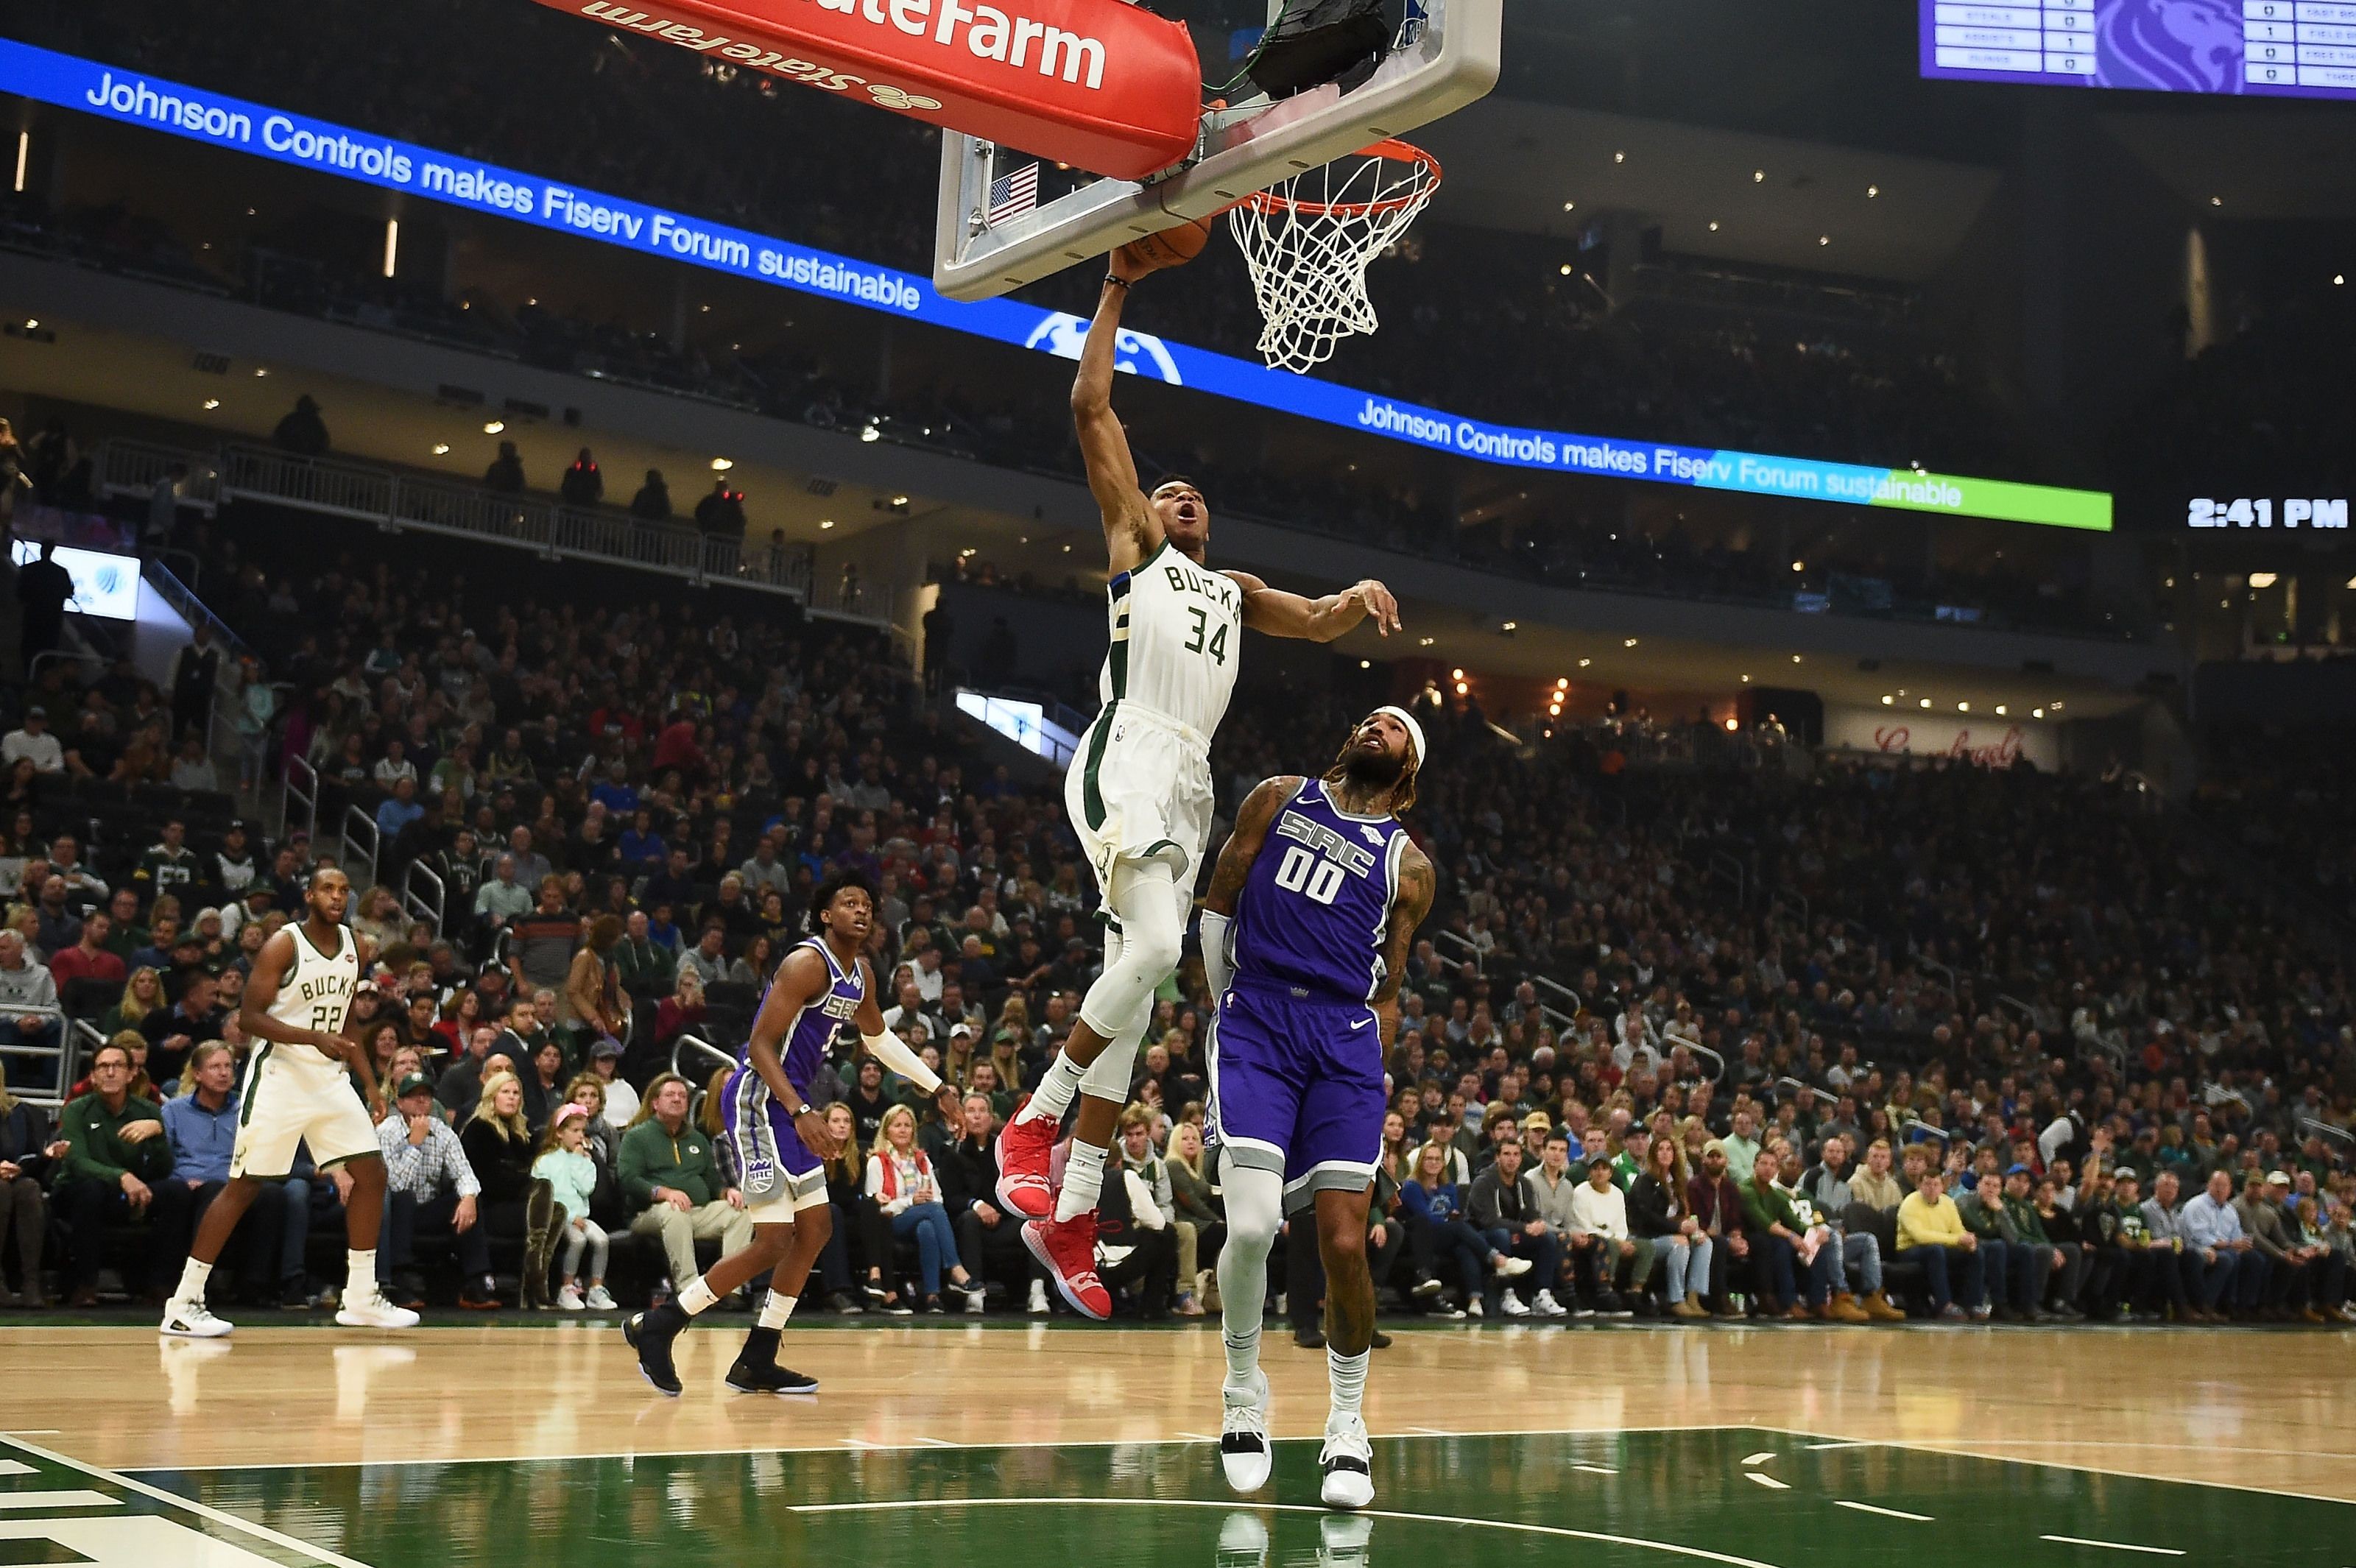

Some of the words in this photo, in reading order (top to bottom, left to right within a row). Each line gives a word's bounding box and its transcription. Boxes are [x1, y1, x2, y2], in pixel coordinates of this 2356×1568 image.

[87, 72, 251, 143] Johnson
[263, 116, 412, 183] Controls
[422, 163, 534, 213] makes
[543, 186, 643, 240] Fiserv
[652, 215, 750, 269] Forum
[758, 249, 920, 311] sustainable
[1358, 398, 1450, 445] Johnson
[1456, 422, 1556, 464] Controls
[1562, 442, 1647, 473] makes
[1654, 448, 1732, 483] Fiserv
[1739, 459, 1818, 491] Forum
[1825, 473, 1962, 507] sustainable
[2188, 498, 2271, 527] 2:41
[2284, 498, 2348, 528] PM
[1184, 606, 1228, 666] 34
[1276, 810, 1376, 878] SAC
[1275, 846, 1346, 905] 00
[311, 1006, 342, 1032] 22
